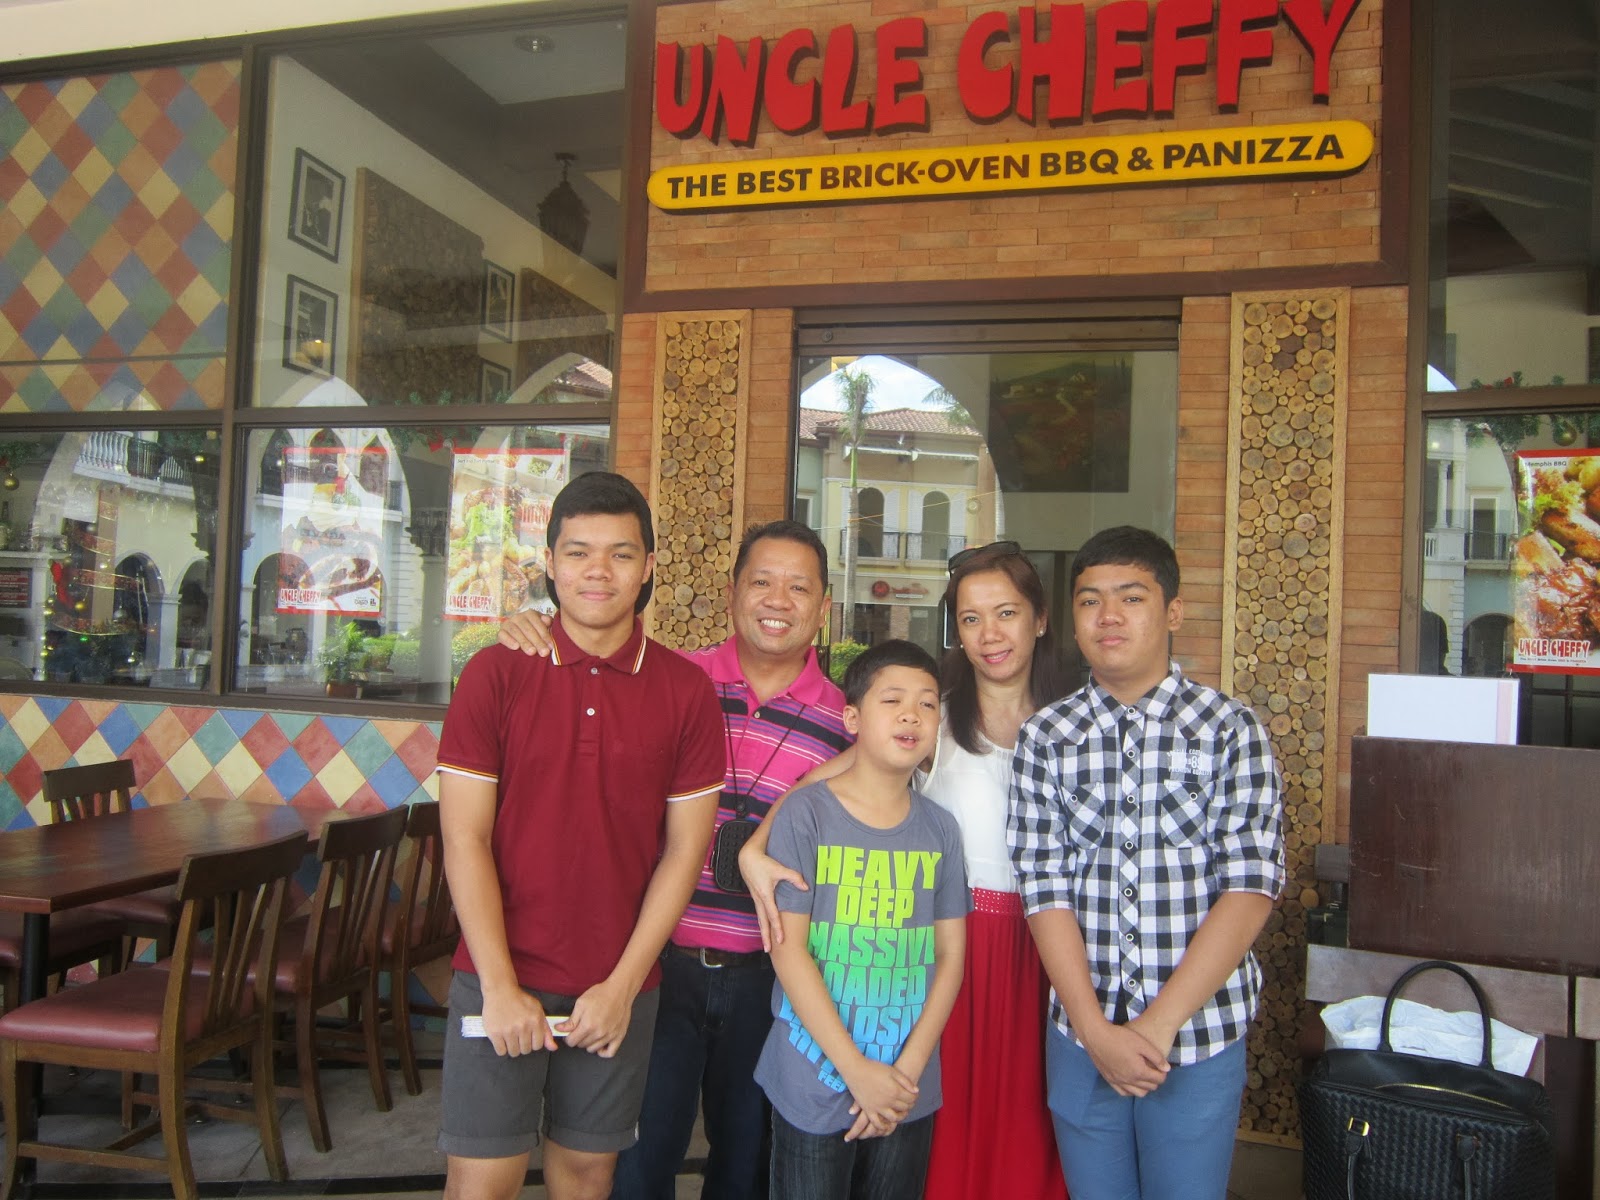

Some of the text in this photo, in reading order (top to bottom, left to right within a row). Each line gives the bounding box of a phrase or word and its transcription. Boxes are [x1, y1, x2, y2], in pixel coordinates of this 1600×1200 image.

[656, 0, 1361, 147] UNCLE CHEFFY
[667, 134, 1344, 199] THE BEST BRICK-OVEN BBQ & PANIZZA
[1519, 639, 1590, 658] UNCLE CHEFFY
[816, 845, 942, 890] HEAVY
[836, 885, 915, 929] DEEP
[817, 958, 927, 1008] OADED
